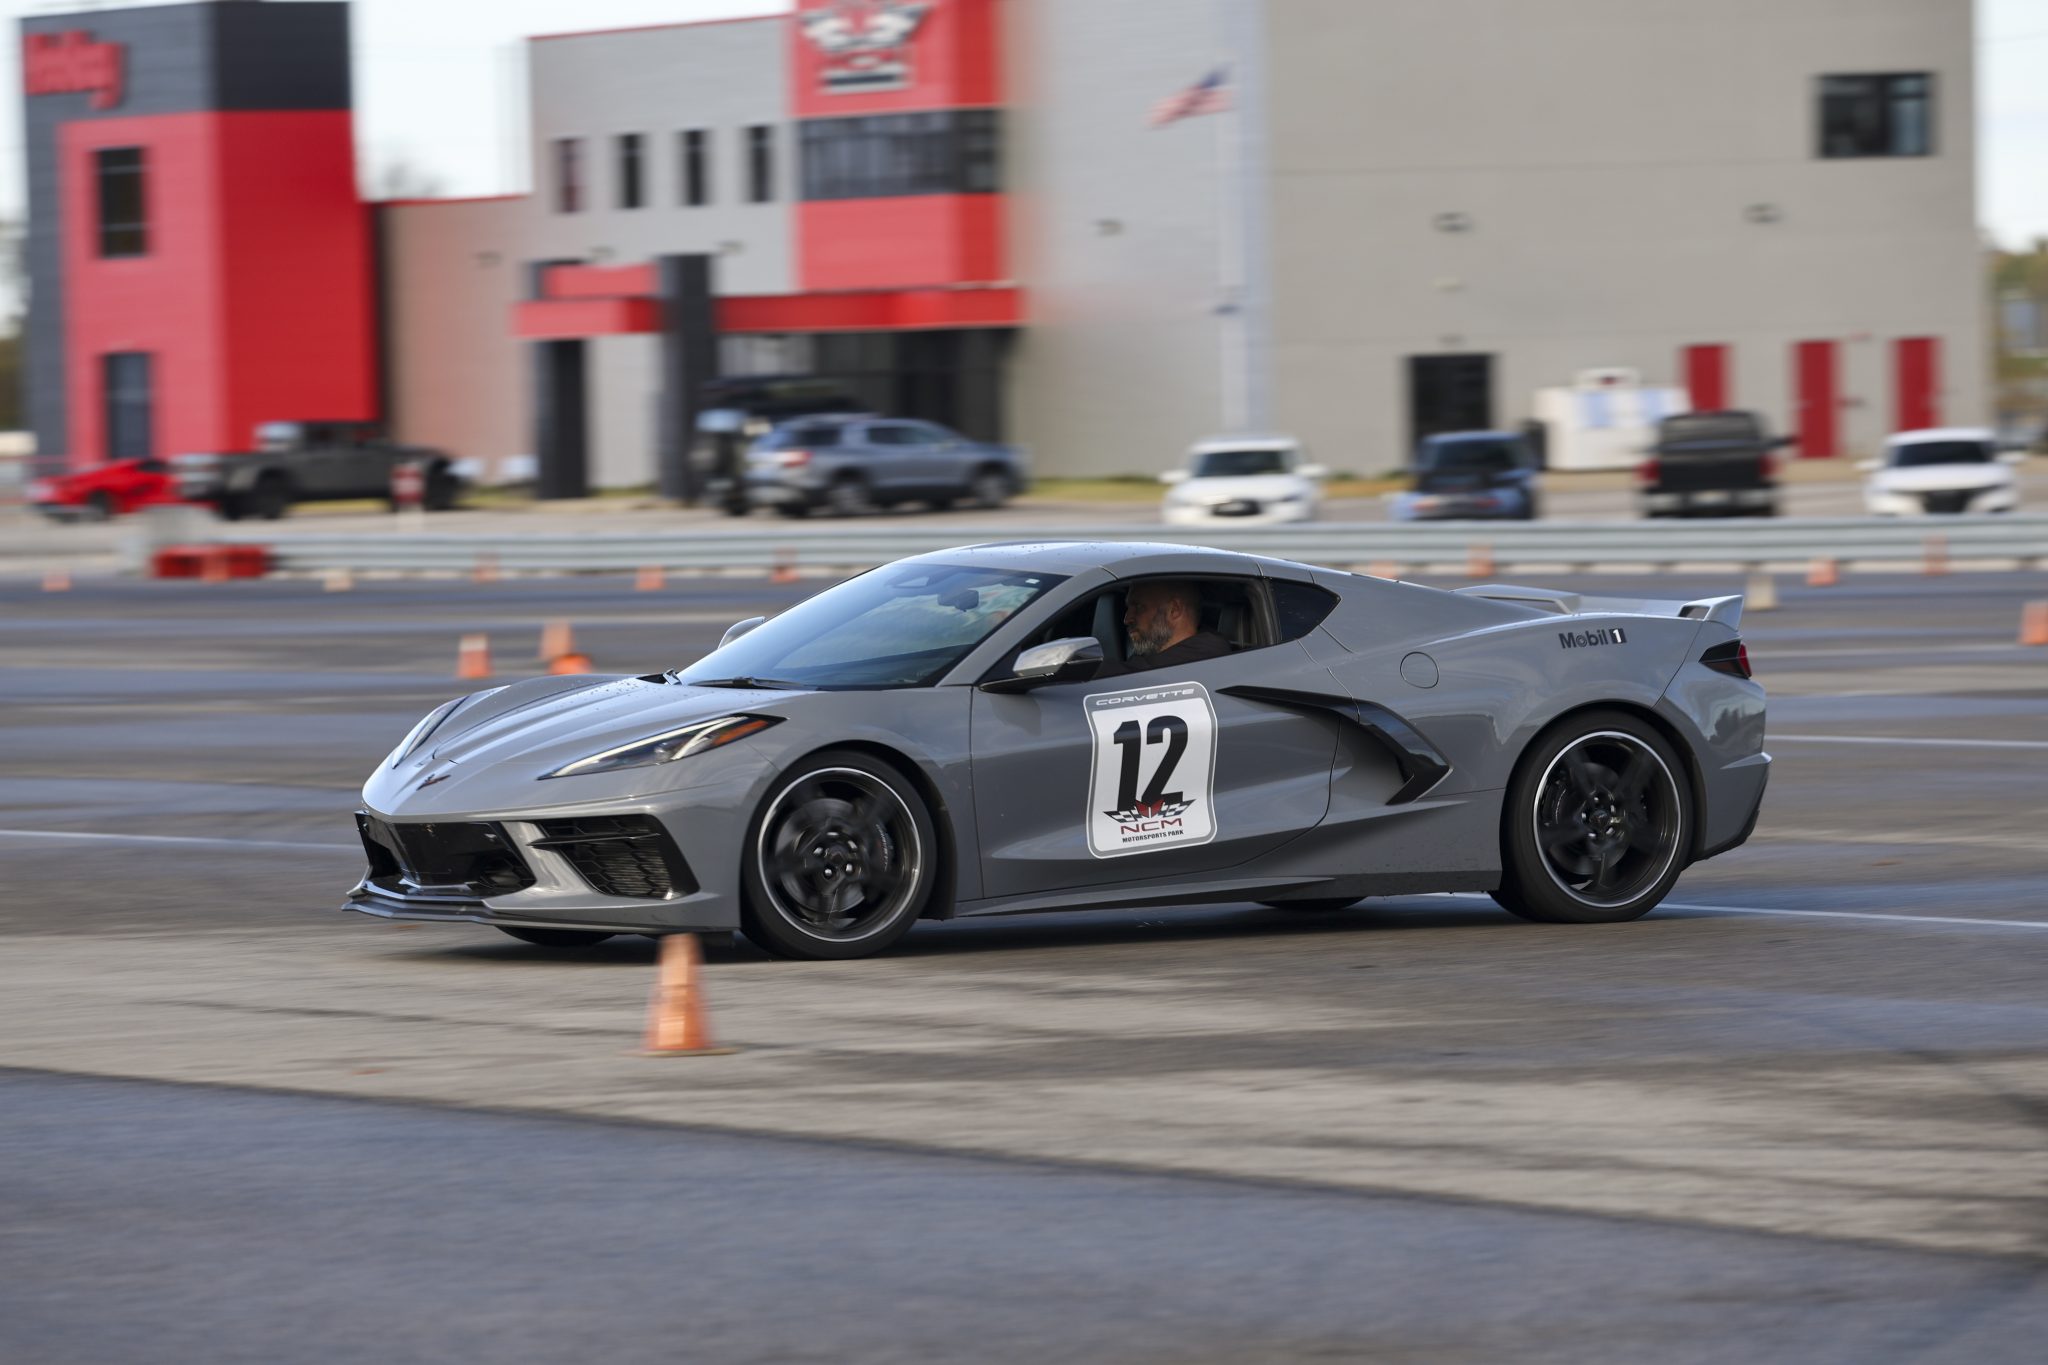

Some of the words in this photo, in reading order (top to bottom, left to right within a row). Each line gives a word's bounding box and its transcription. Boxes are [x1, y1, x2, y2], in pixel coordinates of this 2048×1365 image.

[1559, 629, 1608, 649] Mobil
[1611, 628, 1623, 643] 1
[1096, 688, 1195, 706] CORVETTE
[1113, 715, 1188, 812] 12
[1120, 818, 1183, 834] NCM
[1122, 831, 1167, 843] MOTORSPORTS
[1167, 829, 1184, 837] PARK
